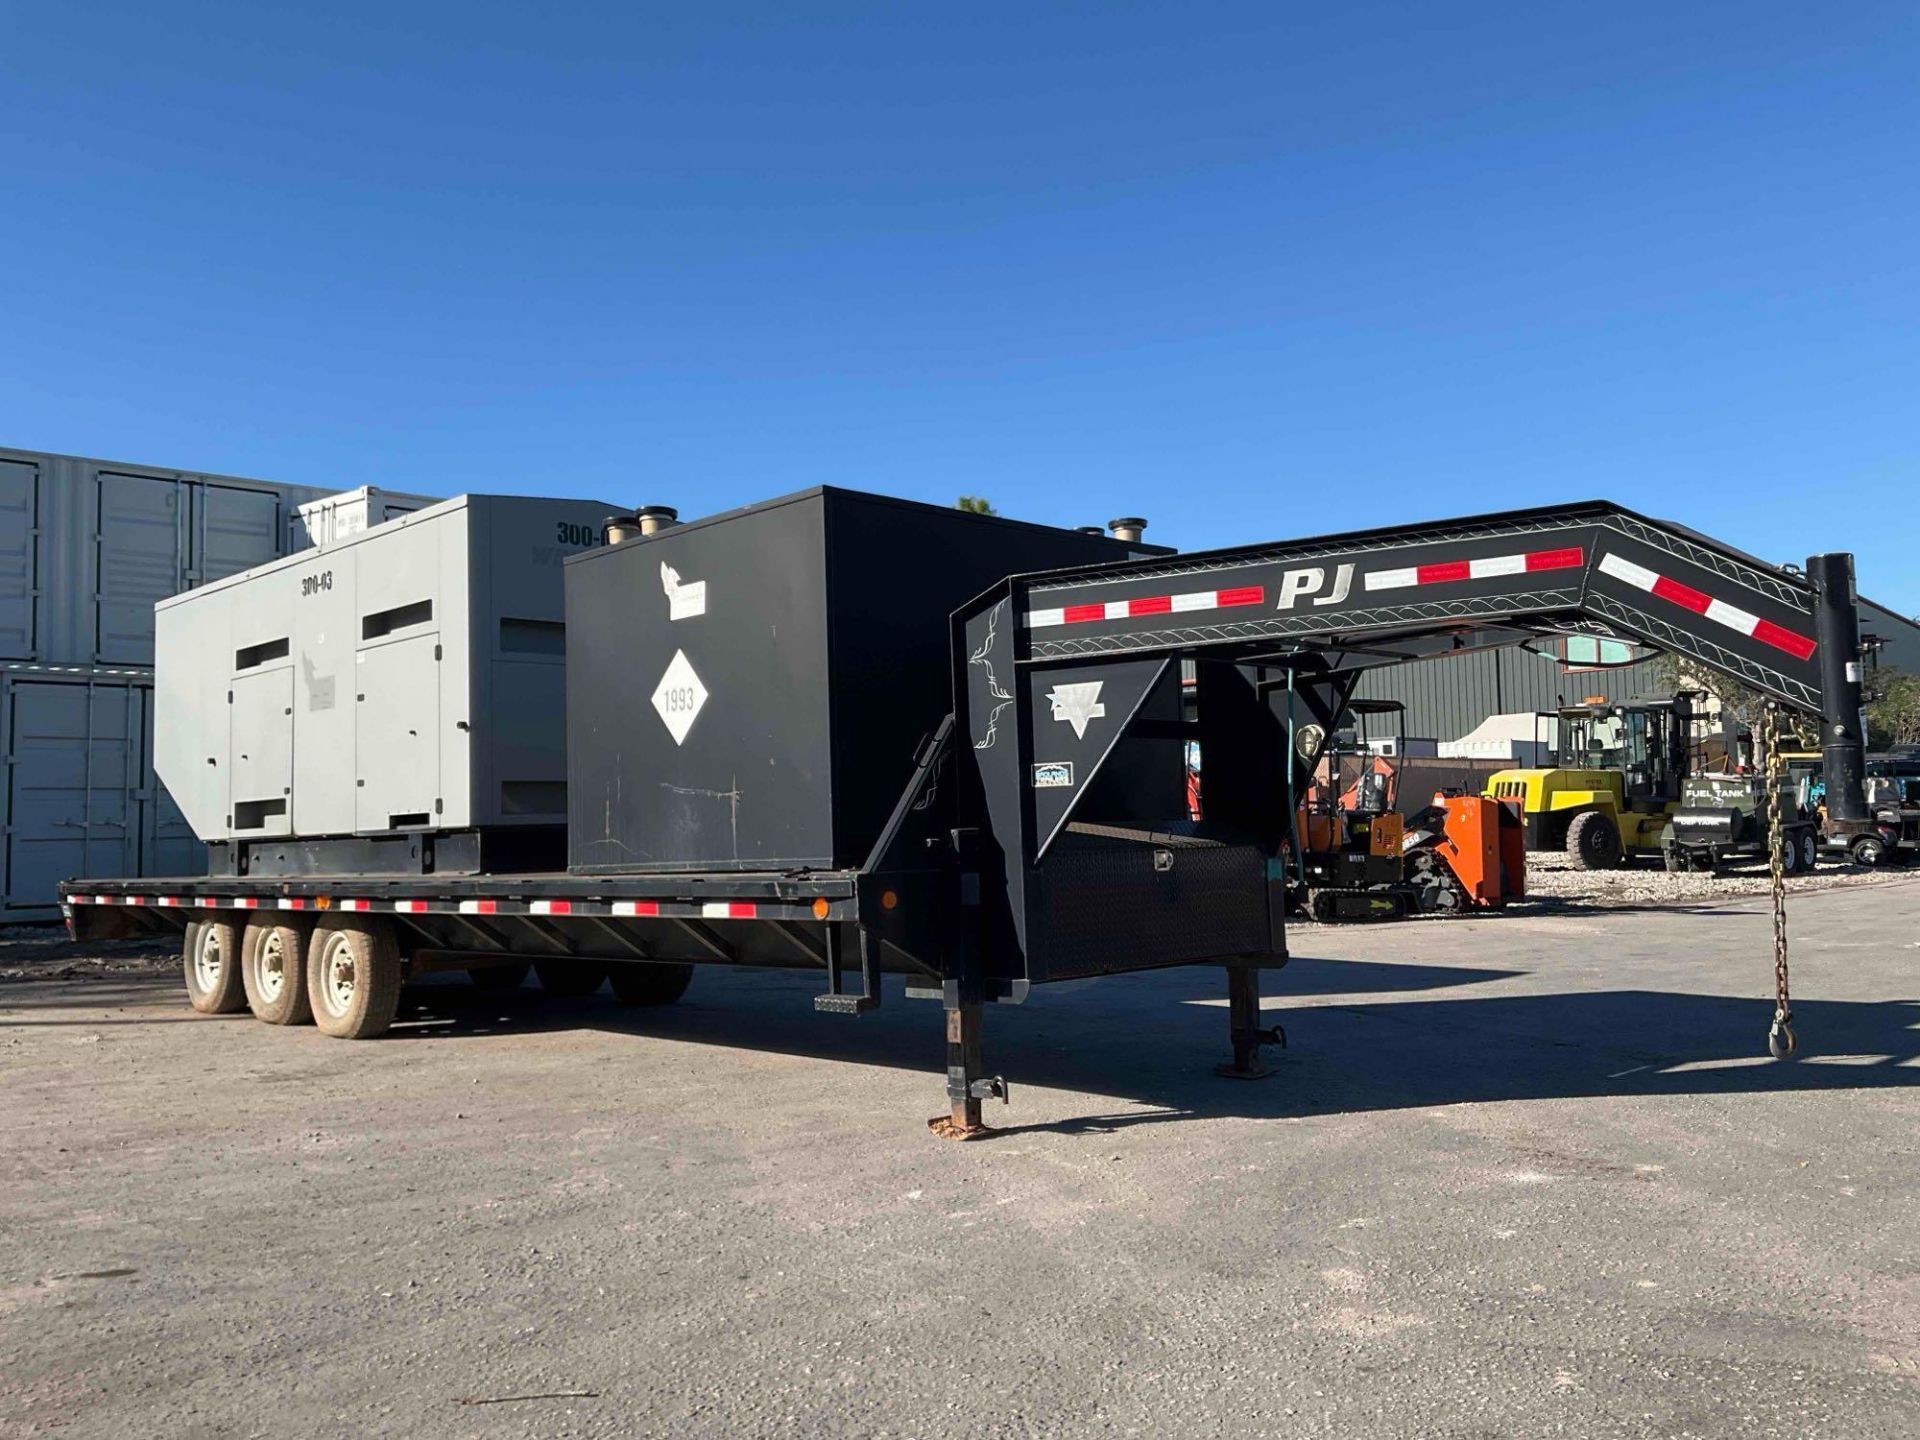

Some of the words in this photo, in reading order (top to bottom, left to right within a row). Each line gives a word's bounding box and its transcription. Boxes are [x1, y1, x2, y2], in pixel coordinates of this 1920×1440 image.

[302, 571, 332, 597] 300-03
[1276, 563, 1356, 610] PJ
[664, 687, 694, 713] 1993
[1686, 790, 1712, 798] FUEL
[1716, 790, 1744, 798] TANK
